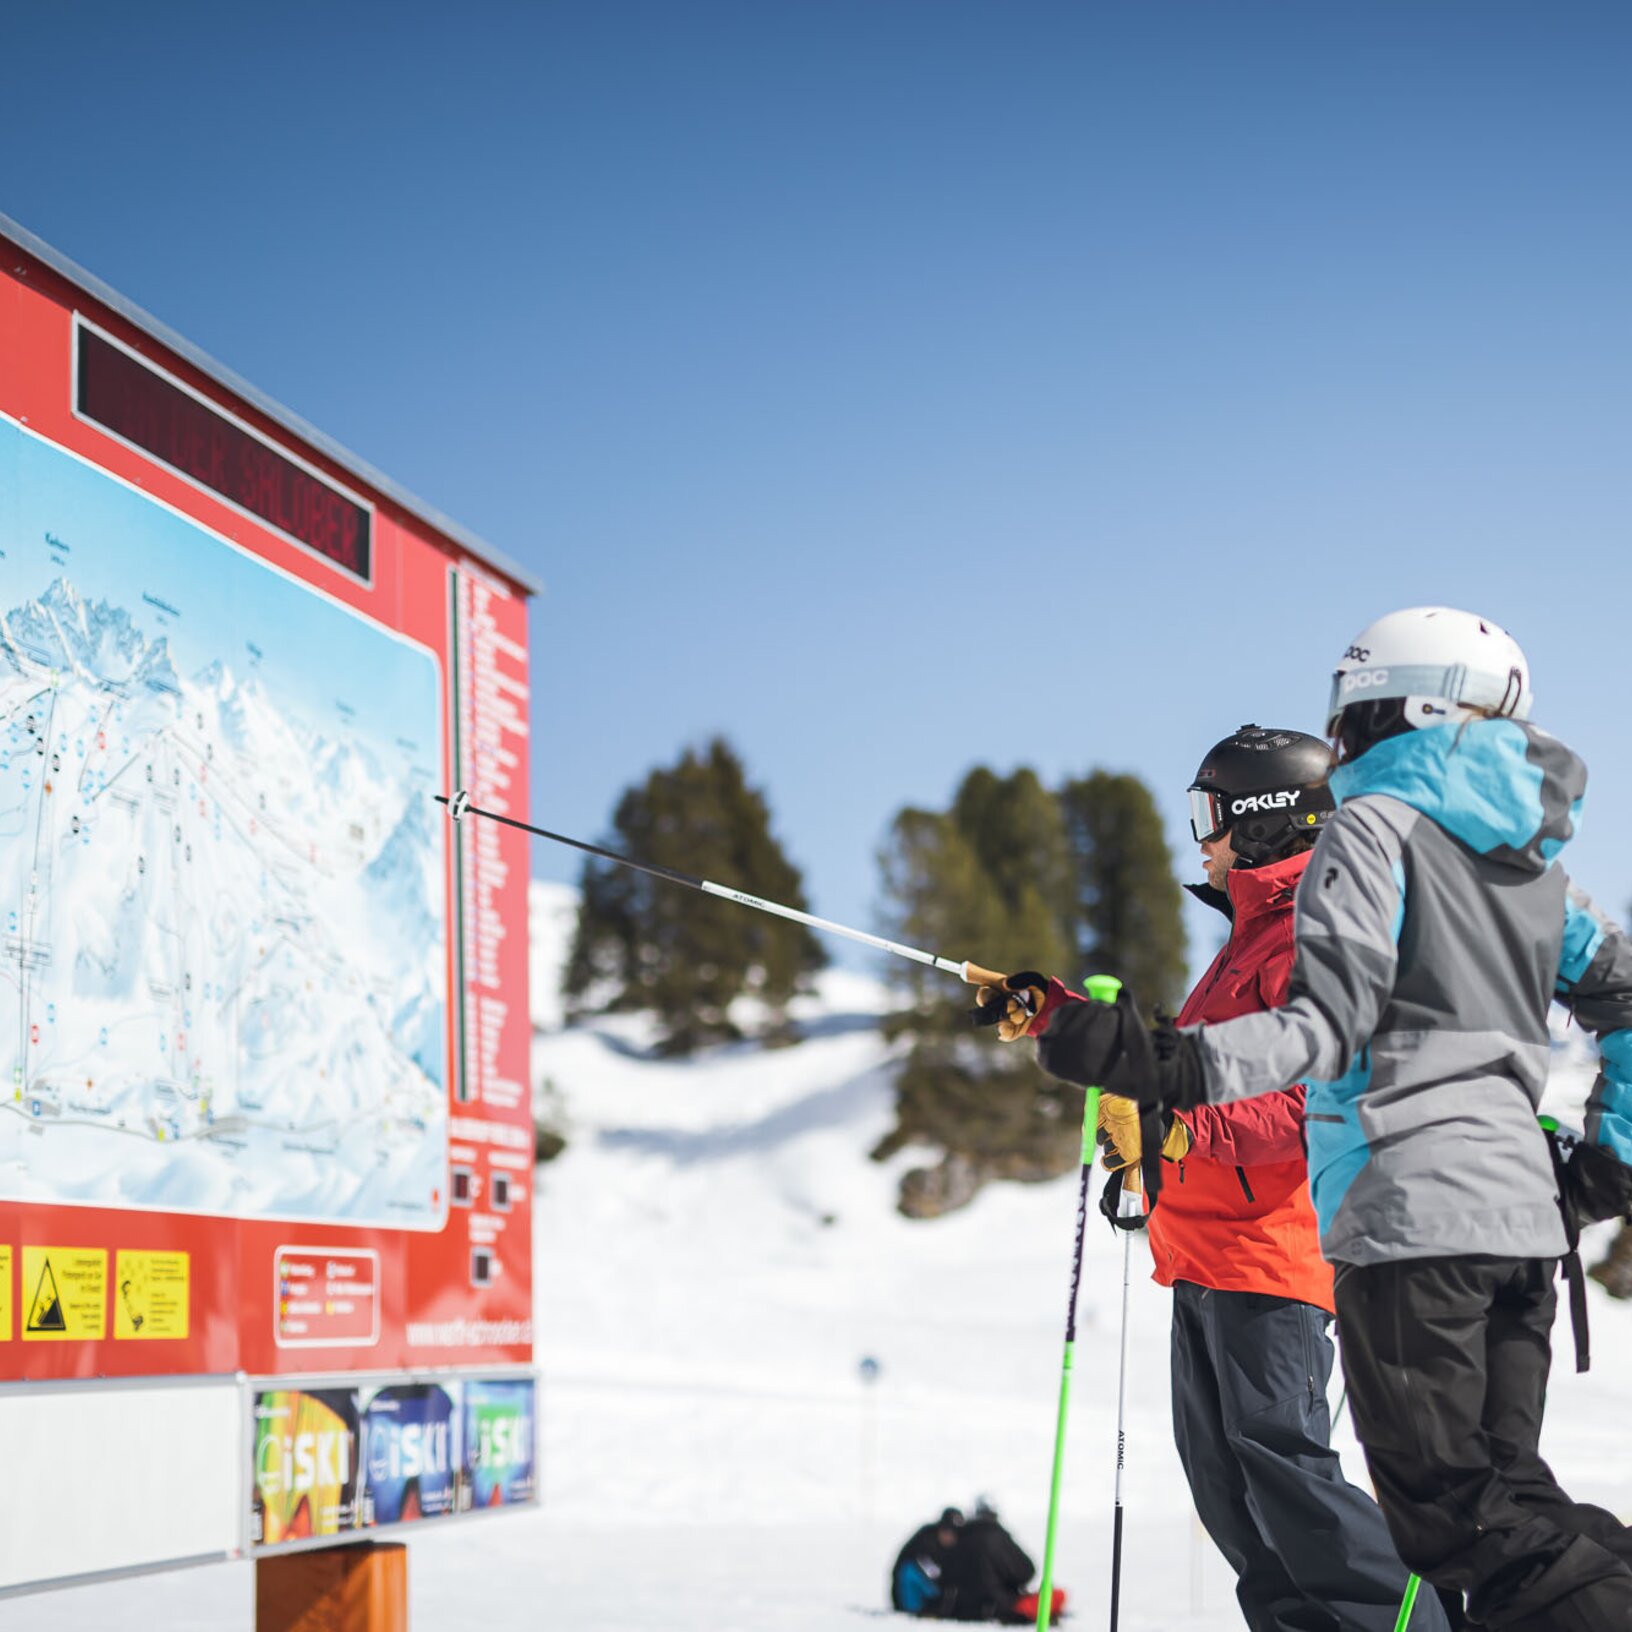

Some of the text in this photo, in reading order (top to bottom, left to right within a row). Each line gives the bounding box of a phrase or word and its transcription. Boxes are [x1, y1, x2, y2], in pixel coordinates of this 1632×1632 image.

[1231, 790, 1301, 815] OAKLEY
[733, 894, 766, 908] ATOMIC
[283, 1432, 350, 1491] iSKI
[389, 1422, 447, 1479] iSKI
[1116, 1430, 1125, 1470] ATOMIC
